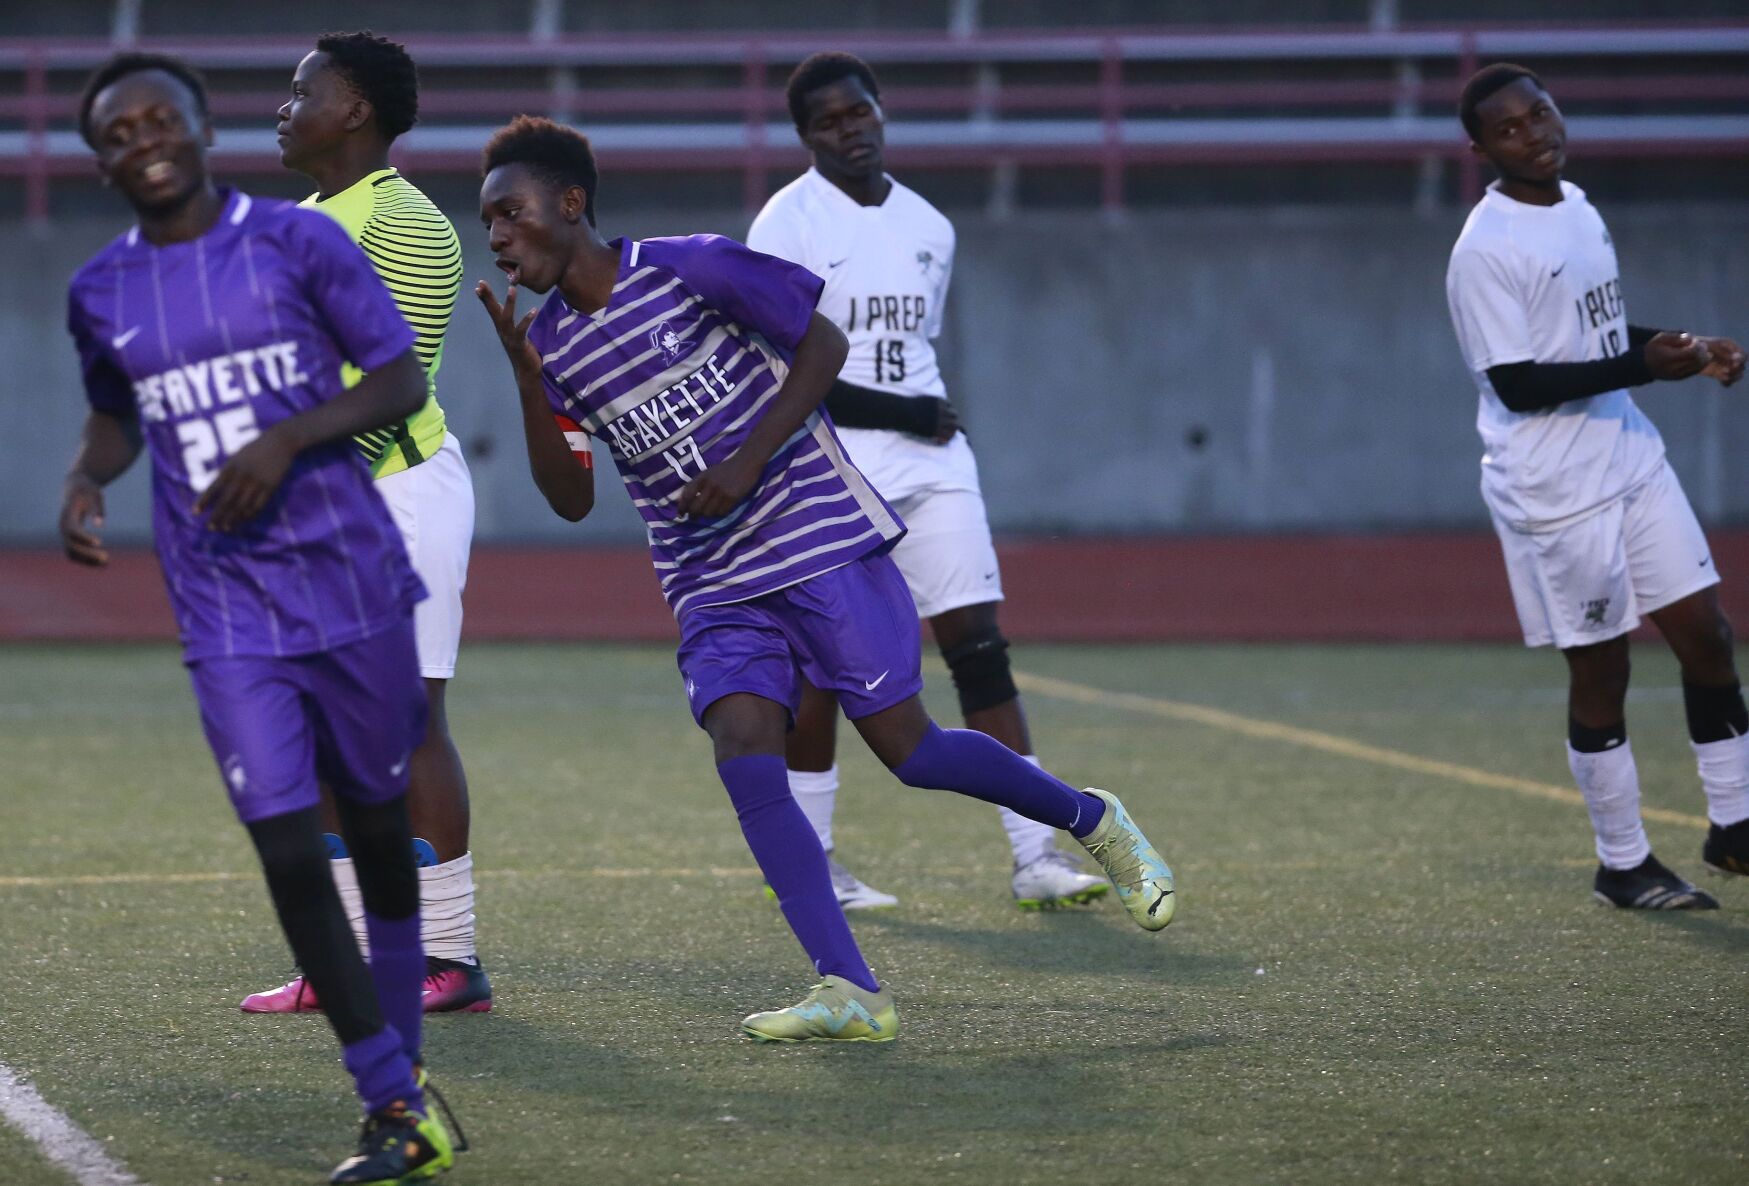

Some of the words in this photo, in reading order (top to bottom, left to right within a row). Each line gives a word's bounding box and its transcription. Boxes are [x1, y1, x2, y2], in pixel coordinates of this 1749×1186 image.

[867, 295, 925, 331] PREP
[875, 340, 905, 382] 19
[663, 436, 707, 482] 17
